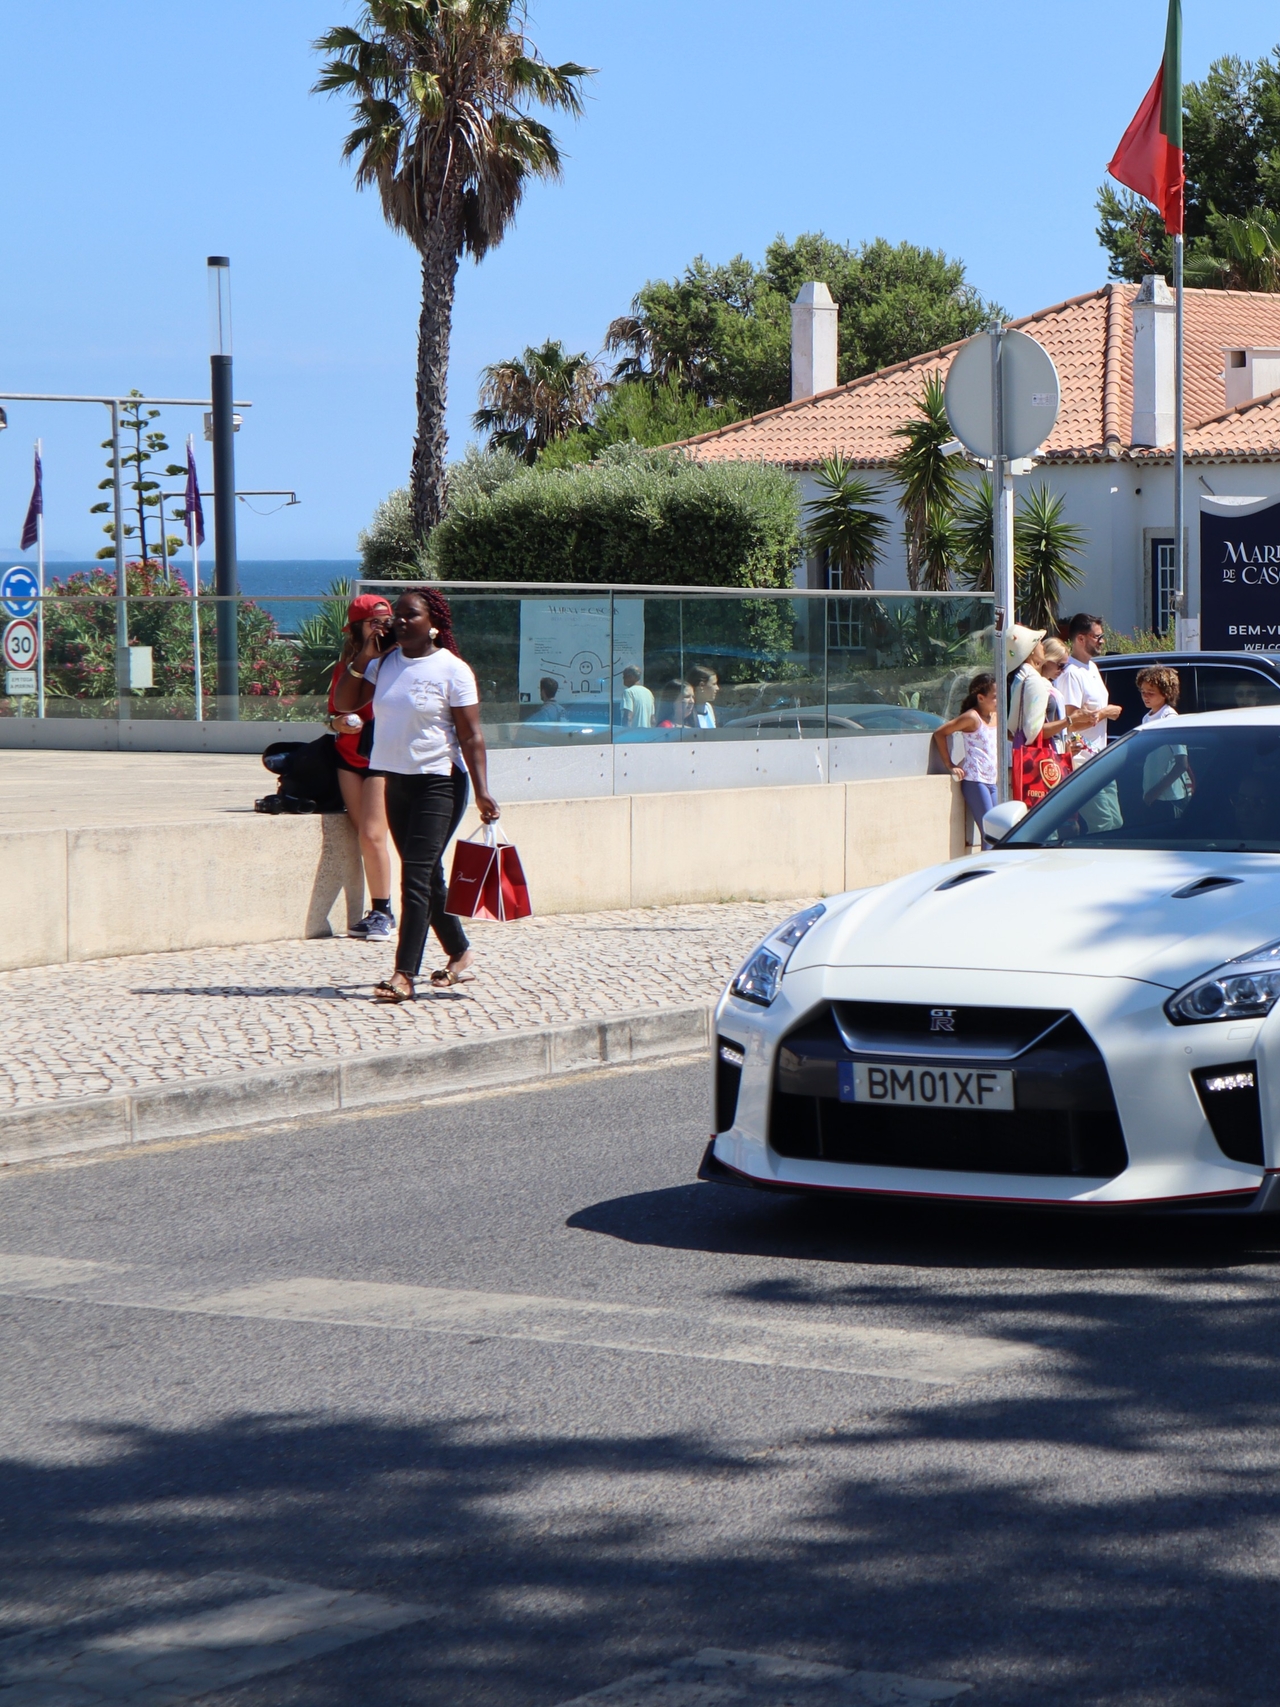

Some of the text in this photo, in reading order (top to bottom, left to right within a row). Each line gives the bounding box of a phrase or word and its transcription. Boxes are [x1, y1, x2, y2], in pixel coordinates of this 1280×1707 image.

[1222, 569, 1236, 583] DE
[11, 636, 31, 653] 30
[930, 1008, 957, 1017] GT
[930, 1017, 955, 1031] R
[868, 1067, 997, 1105] BM01XF
